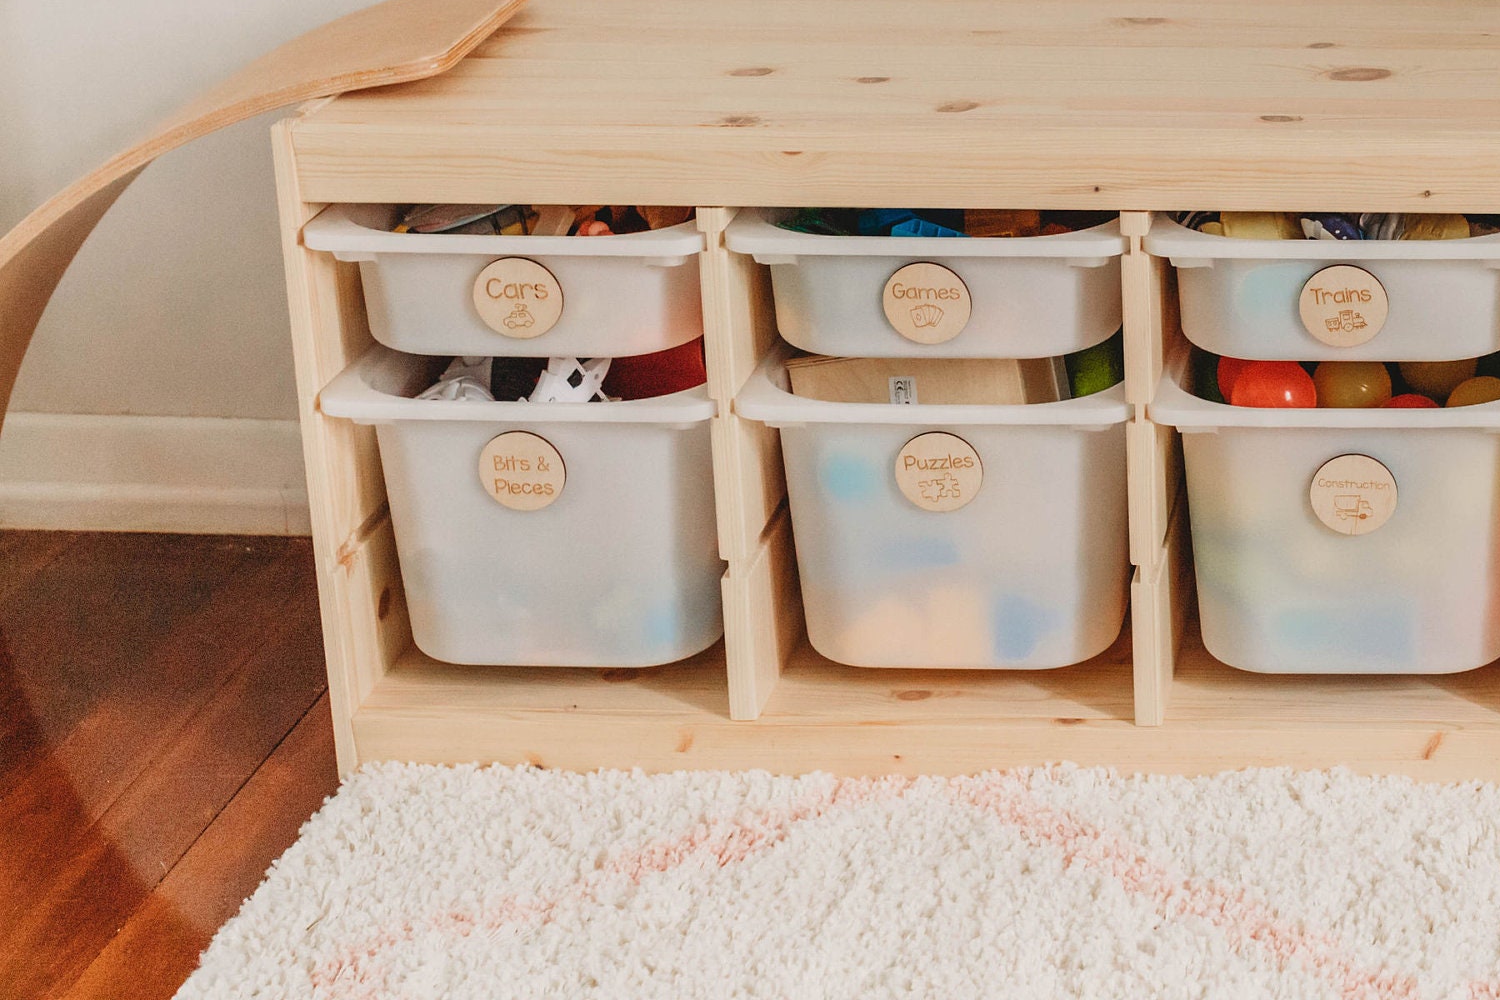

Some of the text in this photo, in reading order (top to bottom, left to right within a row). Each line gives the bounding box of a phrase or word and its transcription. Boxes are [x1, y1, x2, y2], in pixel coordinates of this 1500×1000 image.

[485, 277, 549, 300] Cars
[892, 281, 960, 301] Games
[1309, 287, 1372, 305] Trains
[493, 455, 550, 472] Bits &
[903, 453, 974, 471] Puzzles
[494, 478, 554, 496] Pieces
[1317, 477, 1390, 490] Construction
